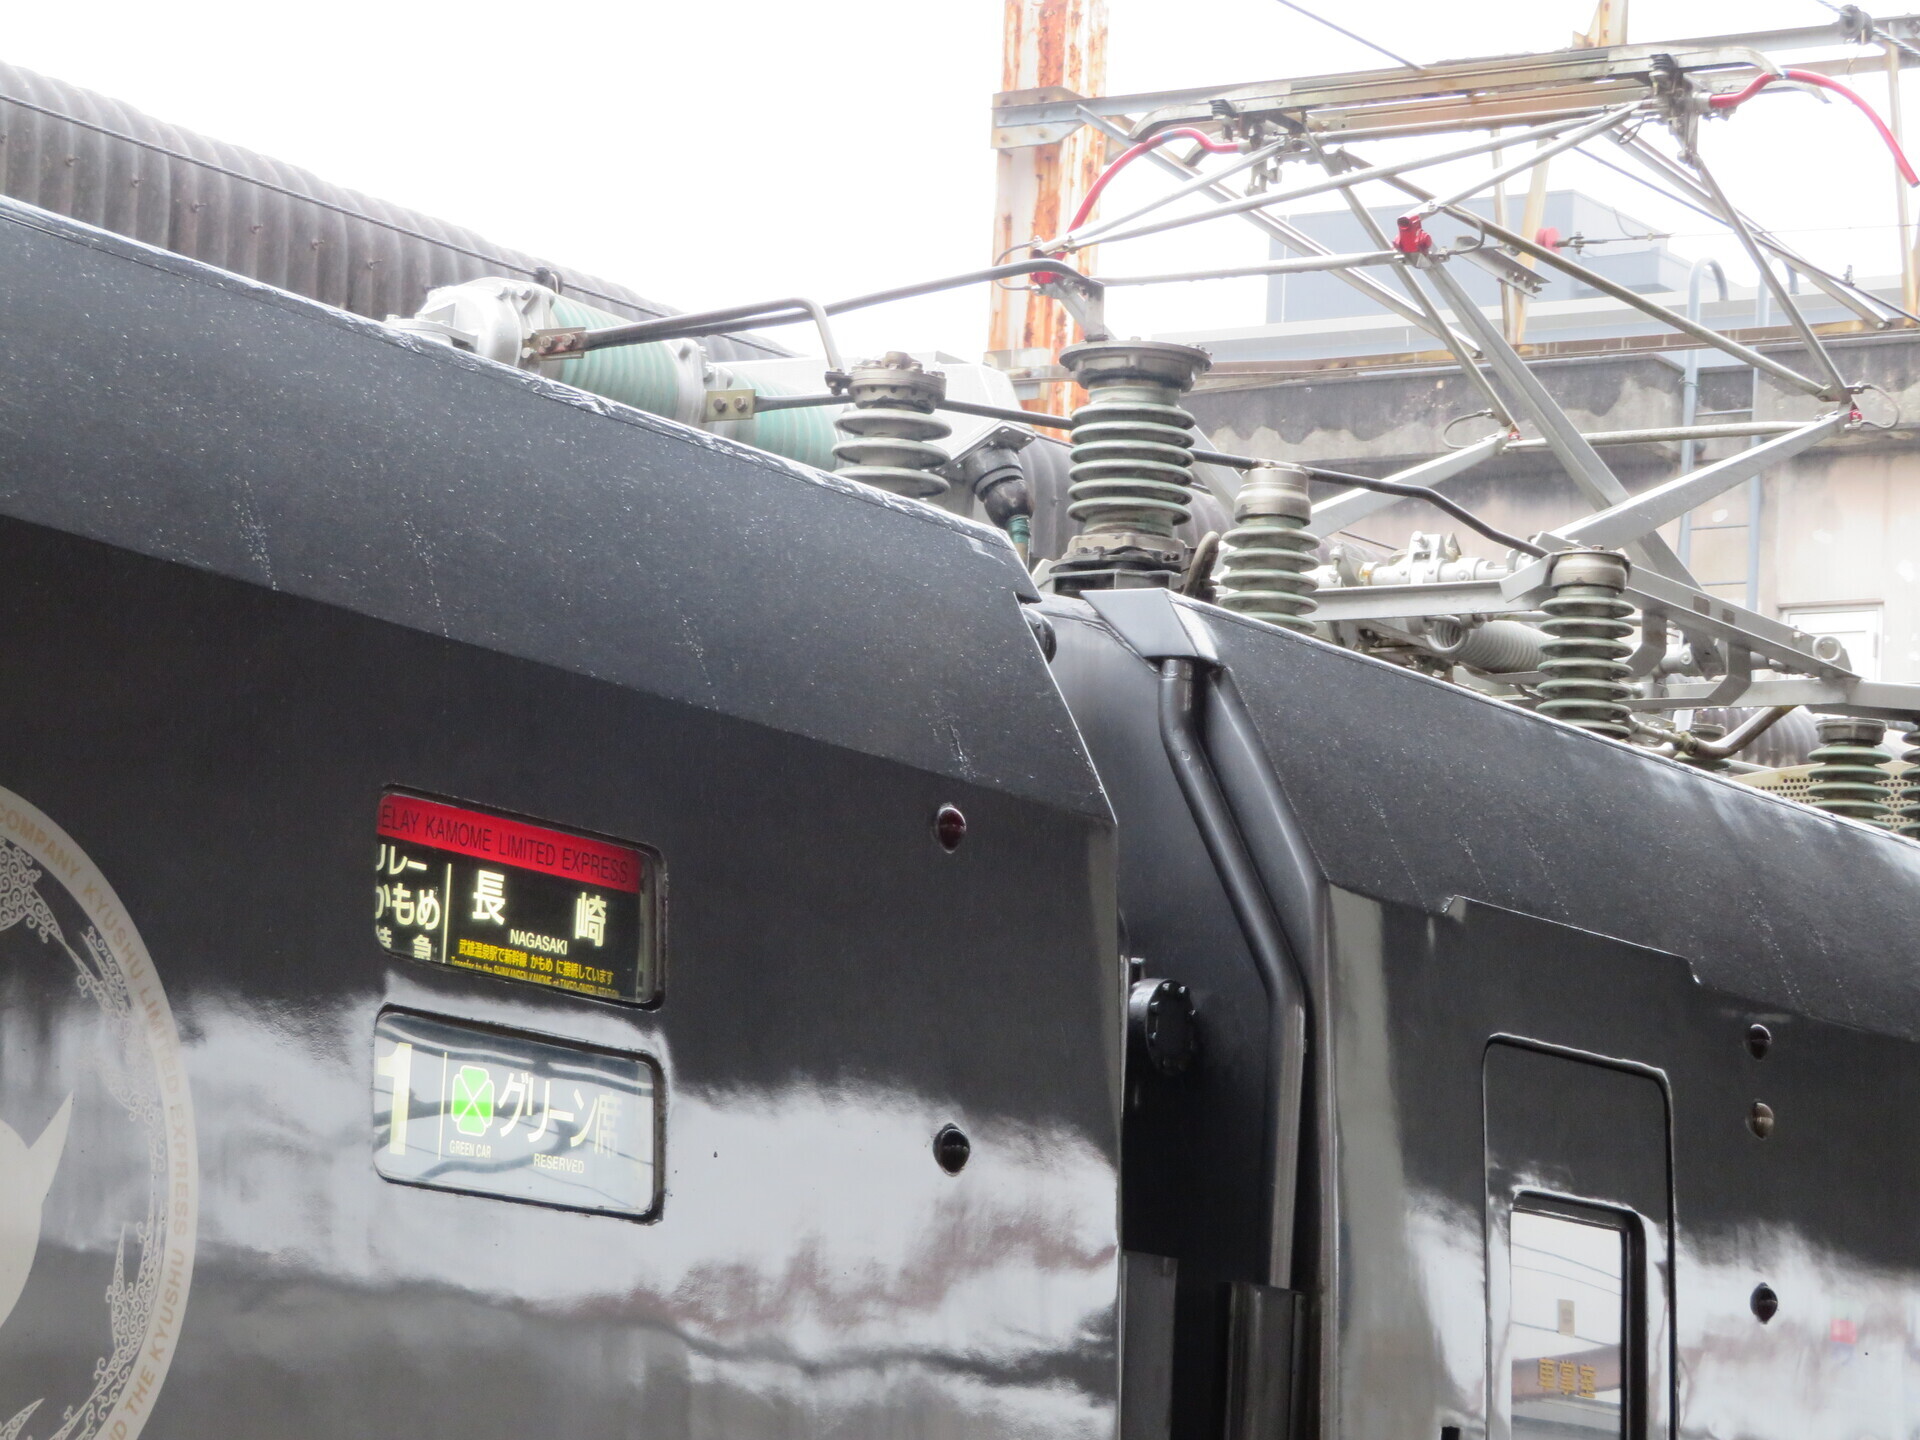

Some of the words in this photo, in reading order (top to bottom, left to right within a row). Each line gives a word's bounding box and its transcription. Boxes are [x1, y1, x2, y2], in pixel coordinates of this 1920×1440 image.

[381, 804, 420, 836] ELAY
[425, 817, 492, 852] KAMOME
[499, 832, 555, 867] LIMITED
[562, 848, 629, 884] EXPRESS
[83, 881, 145, 981] KYUSHU
[375, 882, 440, 931] かもめ
[510, 929, 568, 955] NAGASAKI
[378, 1042, 412, 1156] 1
[450, 1140, 475, 1157] GREEN
[476, 1143, 491, 1158] CAR
[533, 1153, 584, 1174] RESERVED
[124, 1365, 156, 1415] THE
[150, 1249, 185, 1362] KYUSHU
